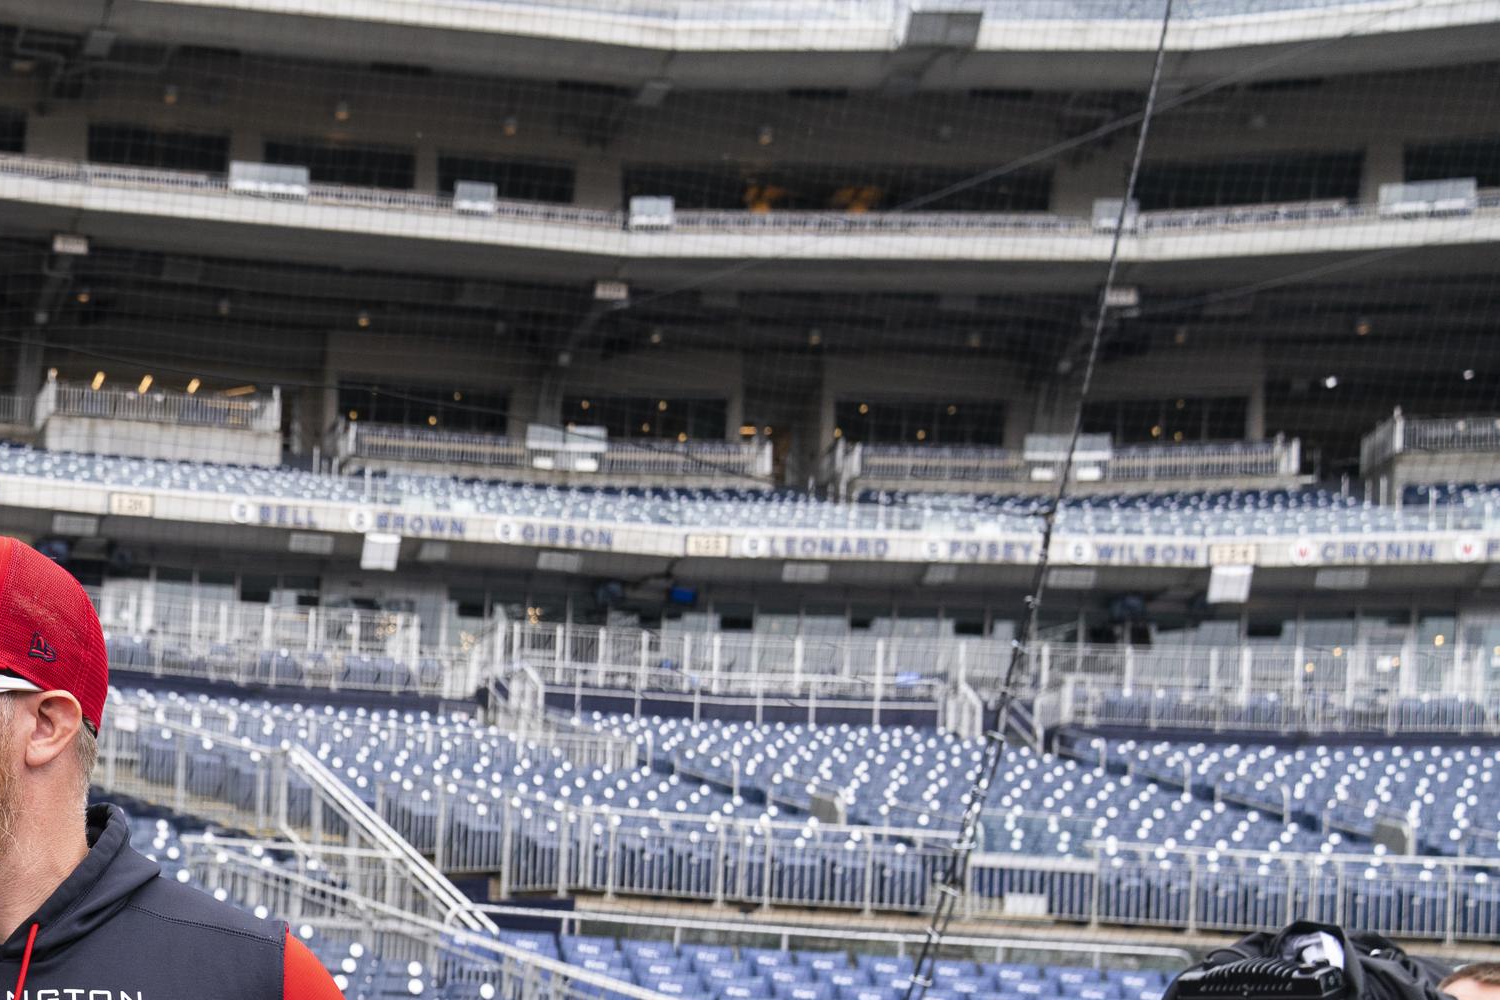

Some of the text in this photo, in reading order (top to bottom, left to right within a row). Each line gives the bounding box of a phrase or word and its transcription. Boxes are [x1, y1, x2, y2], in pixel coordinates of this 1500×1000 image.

[258, 504, 317, 526] BELL
[375, 512, 466, 535] BROWN
[521, 523, 613, 547] GIBSON
[1096, 544, 1197, 563] WILSON
[1320, 541, 1436, 562] CRONIN
